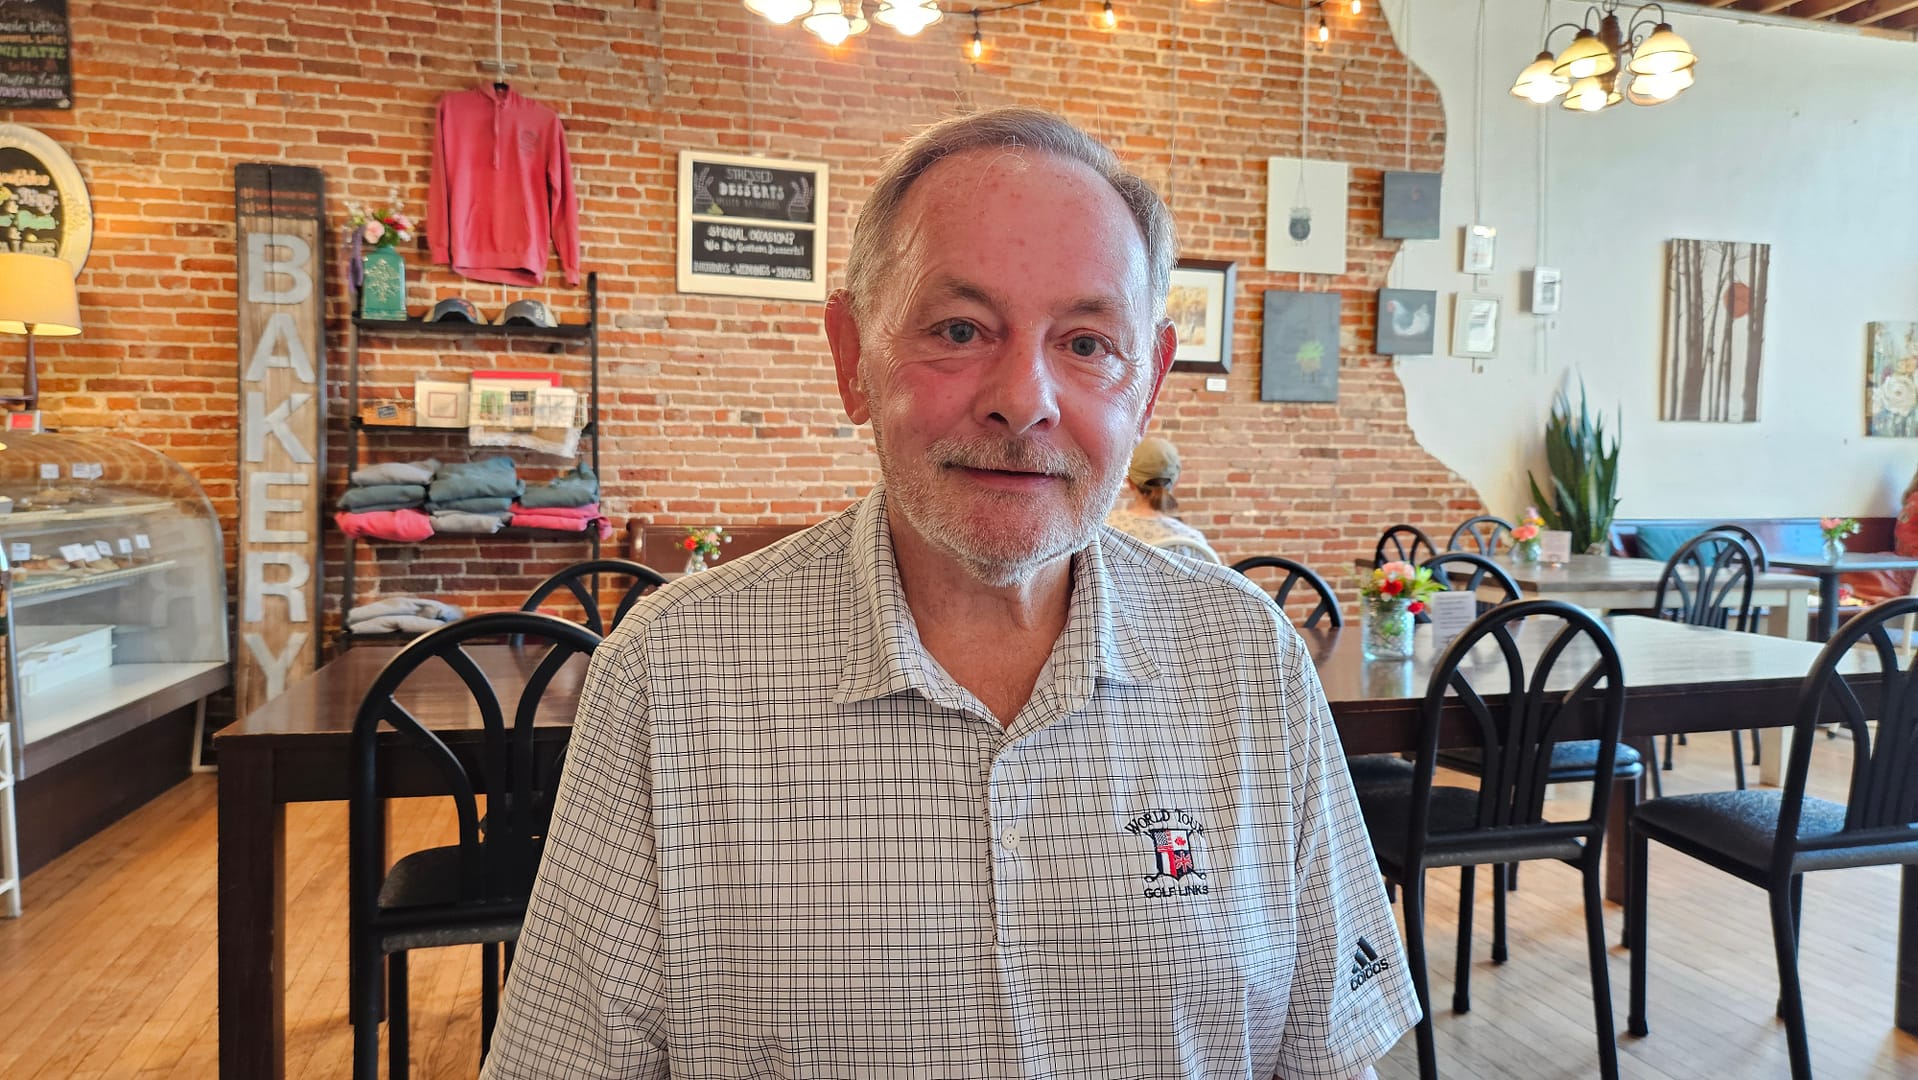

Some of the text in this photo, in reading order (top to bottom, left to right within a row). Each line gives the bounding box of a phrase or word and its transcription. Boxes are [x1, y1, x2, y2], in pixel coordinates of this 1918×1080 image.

[726, 168, 773, 183] STRESSED
[718, 181, 785, 201] DESSERTS
[704, 239, 720, 251] We
[707, 225, 795, 245] SPECIAL OCCASION?
[775, 266, 812, 280] SHOWERS
[244, 232, 315, 701] BAKERY
[1124, 808, 1204, 838] WORLD TOUR
[1143, 884, 1209, 898] GOLF LINKS
[1351, 958, 1389, 991] adidas
